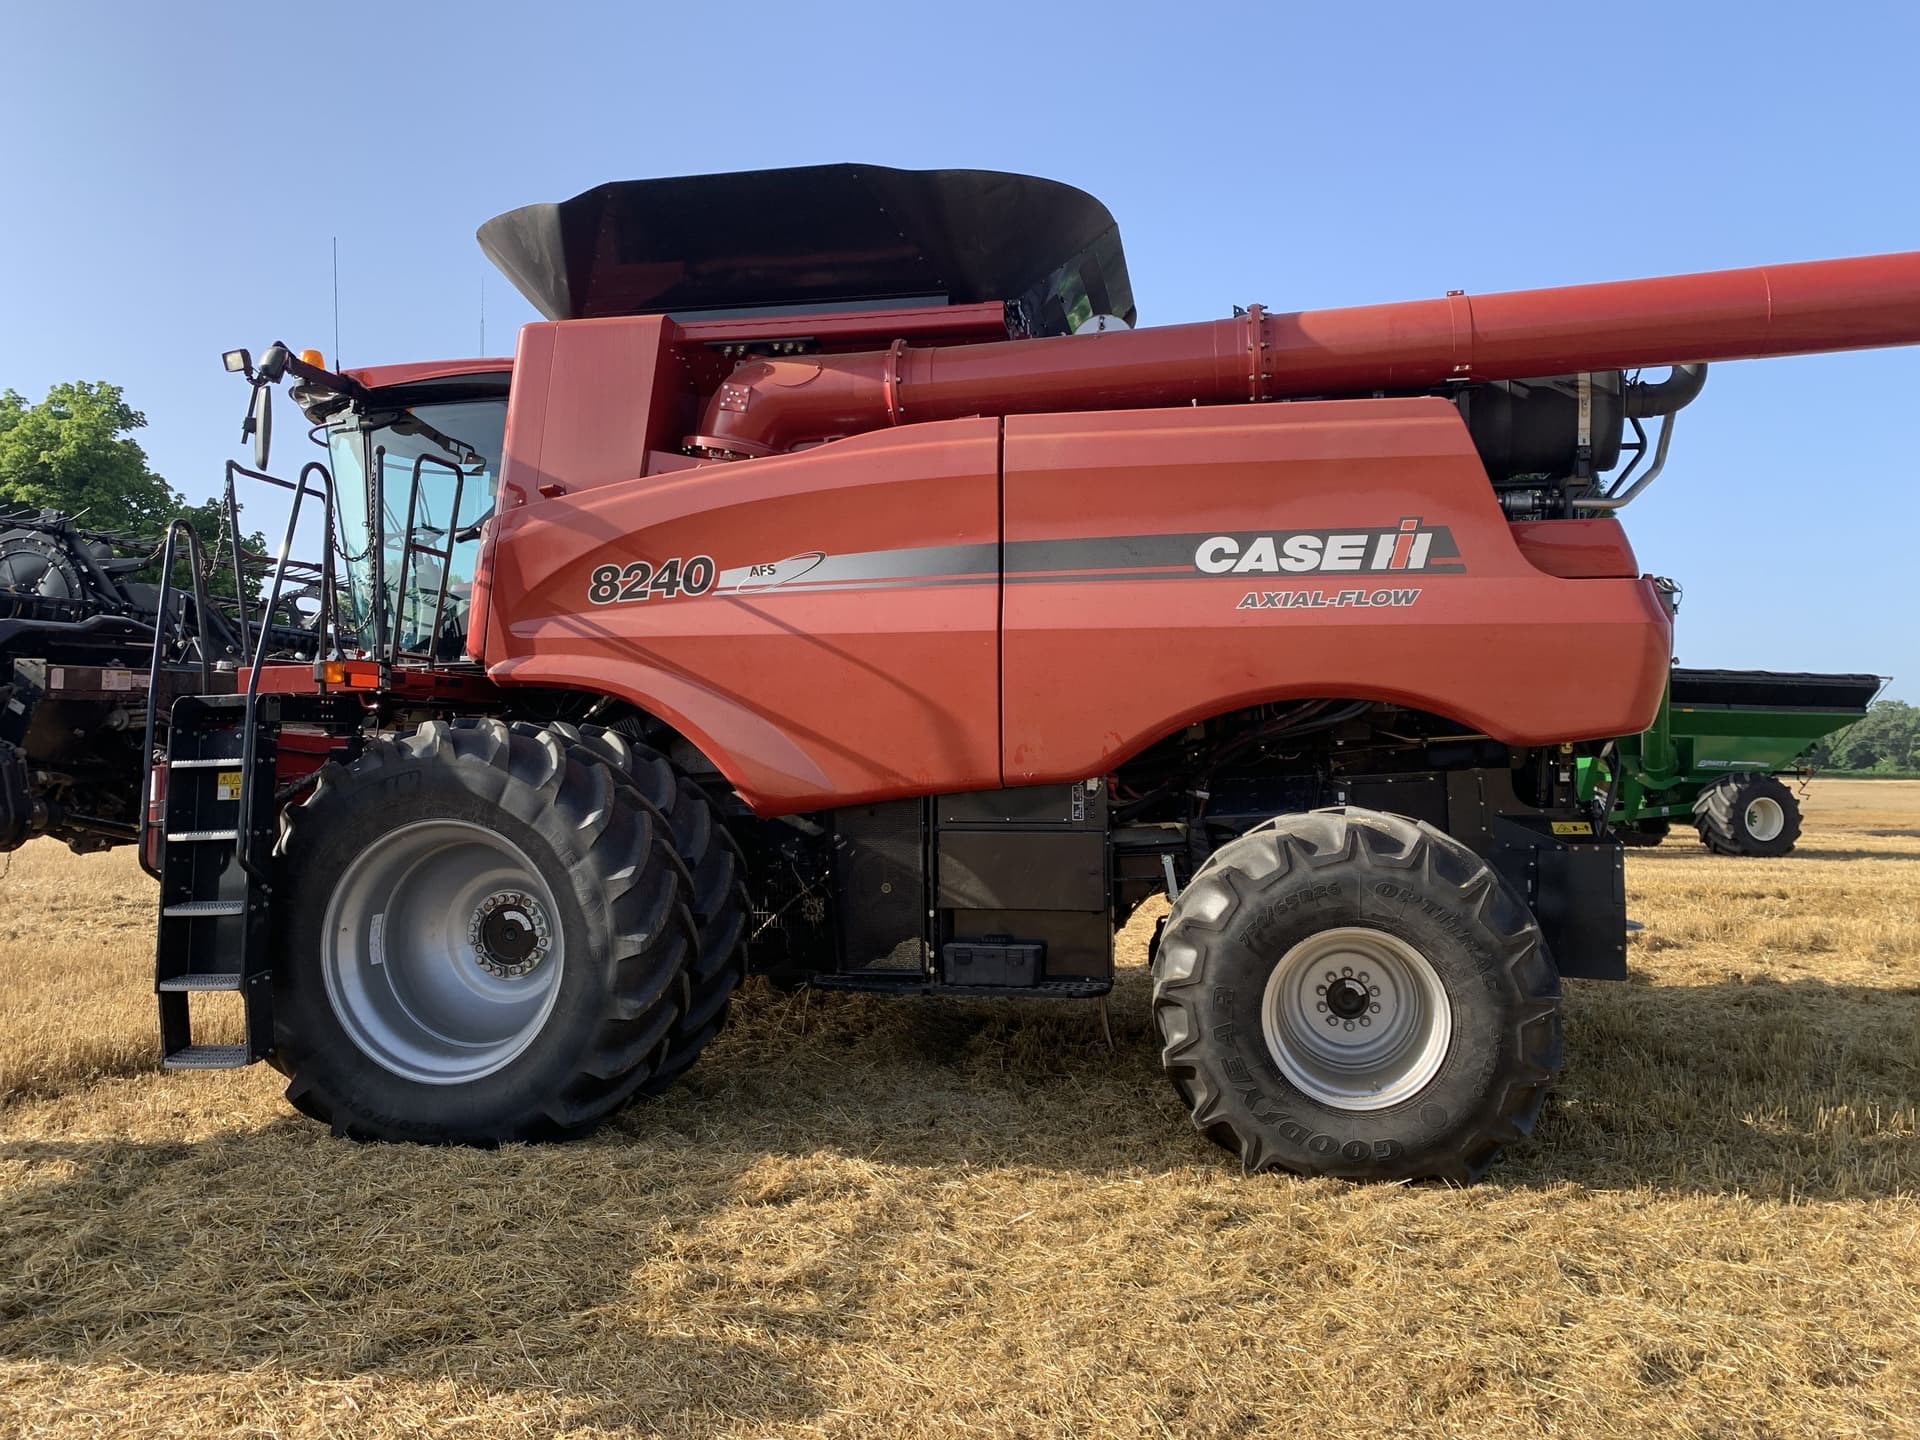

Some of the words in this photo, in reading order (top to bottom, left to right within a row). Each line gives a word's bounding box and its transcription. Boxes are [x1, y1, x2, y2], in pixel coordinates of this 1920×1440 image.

[749, 563, 777, 578] AFS
[1194, 533, 1369, 574] CASE
[587, 555, 716, 606] 8240
[1236, 588, 1423, 610] AXIAL-FLOW
[1212, 985, 1404, 1162] GOODYEAR
